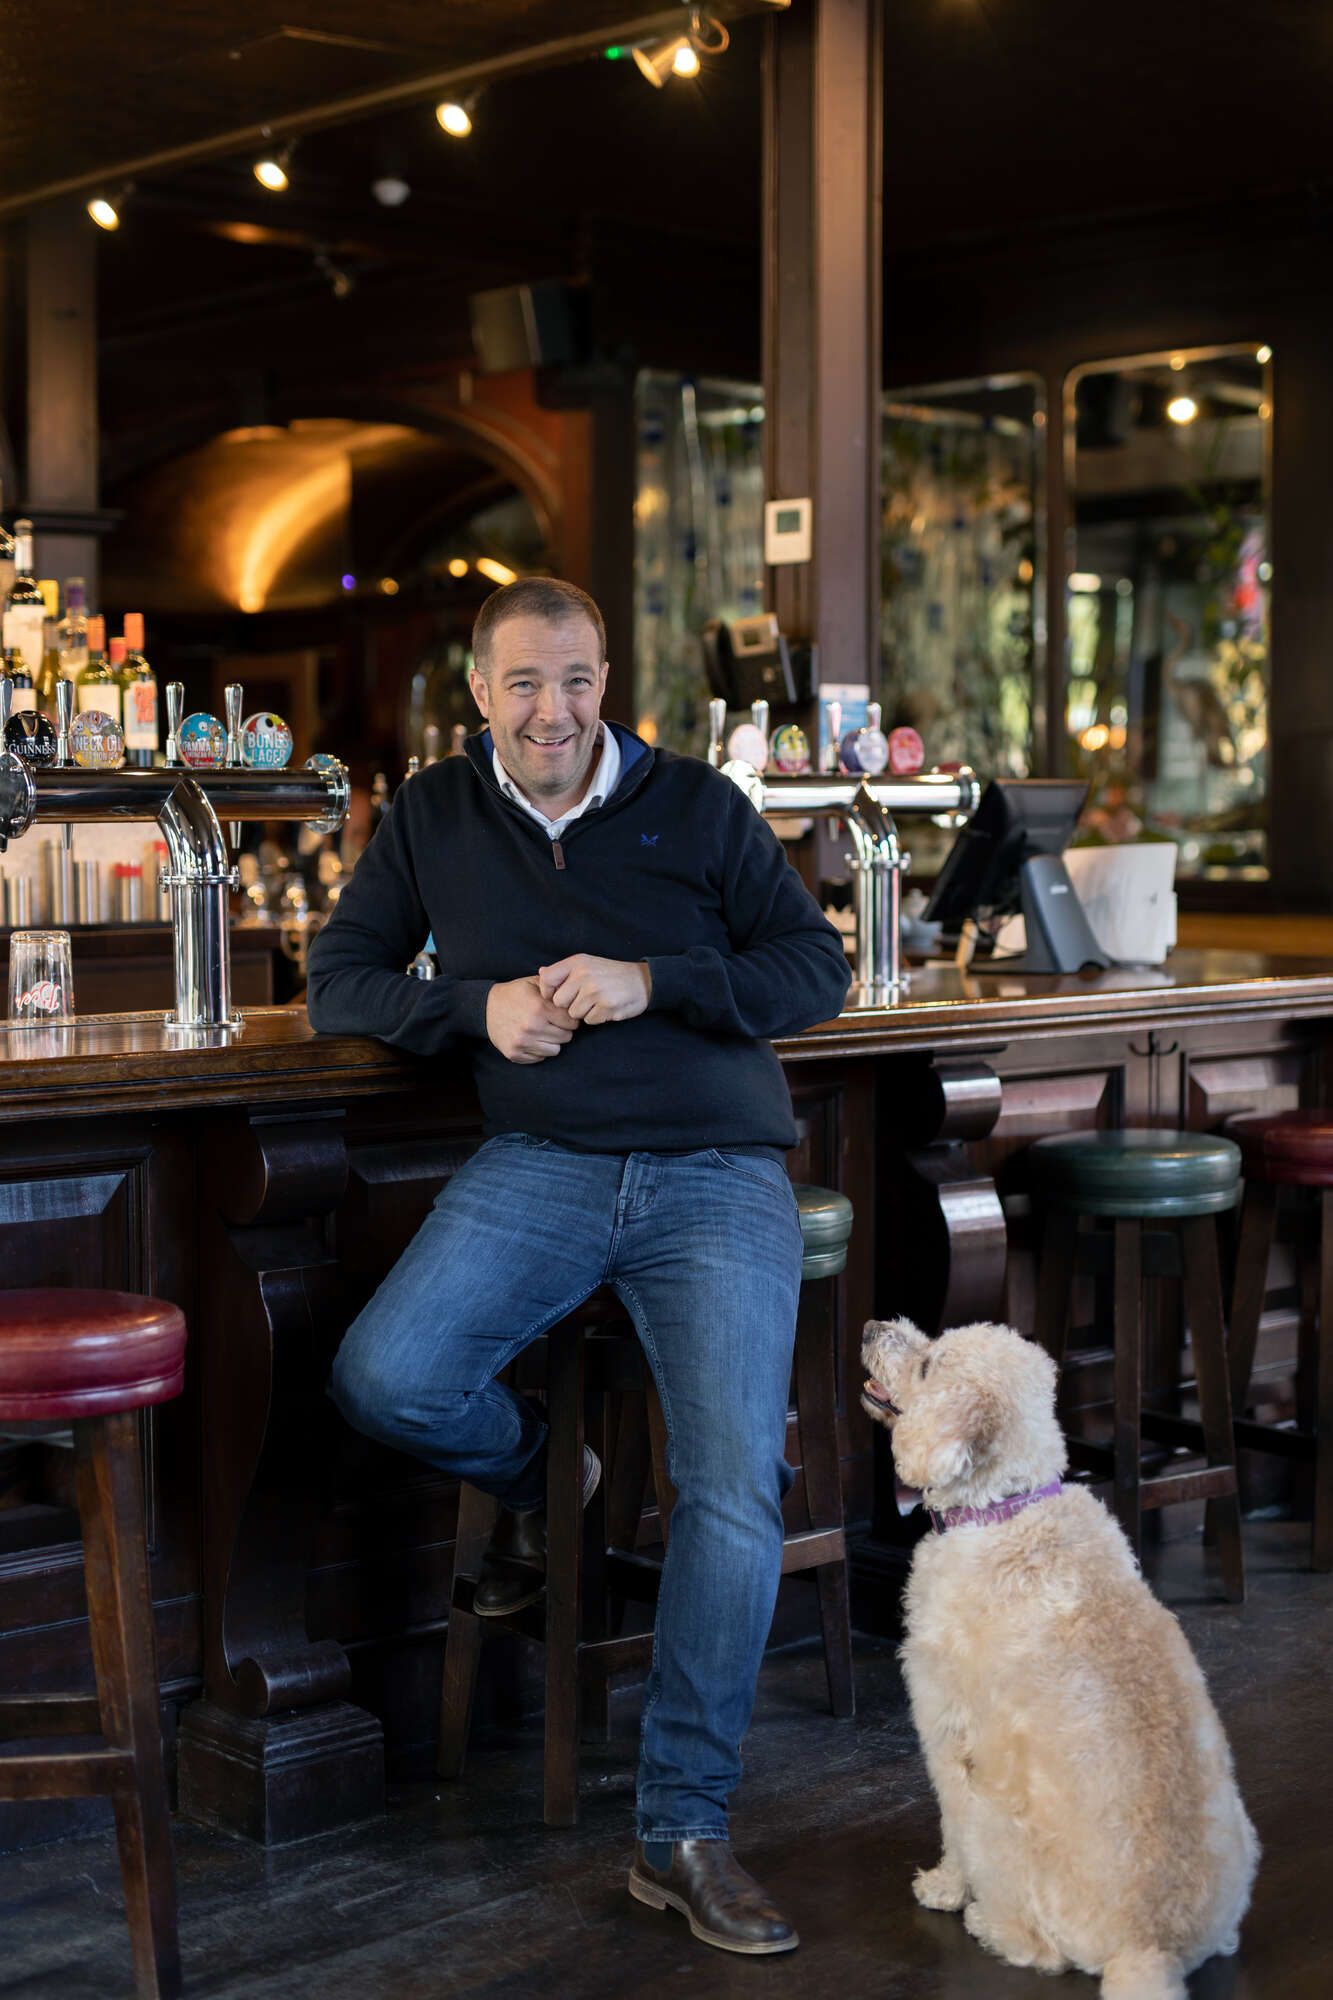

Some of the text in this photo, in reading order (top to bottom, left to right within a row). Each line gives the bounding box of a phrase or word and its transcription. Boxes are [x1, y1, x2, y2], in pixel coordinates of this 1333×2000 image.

[75, 734, 104, 751] NECK
[247, 731, 289, 748] BONES
[9, 743, 57, 755] GUINNESS
[251, 749, 287, 764] LAGER
